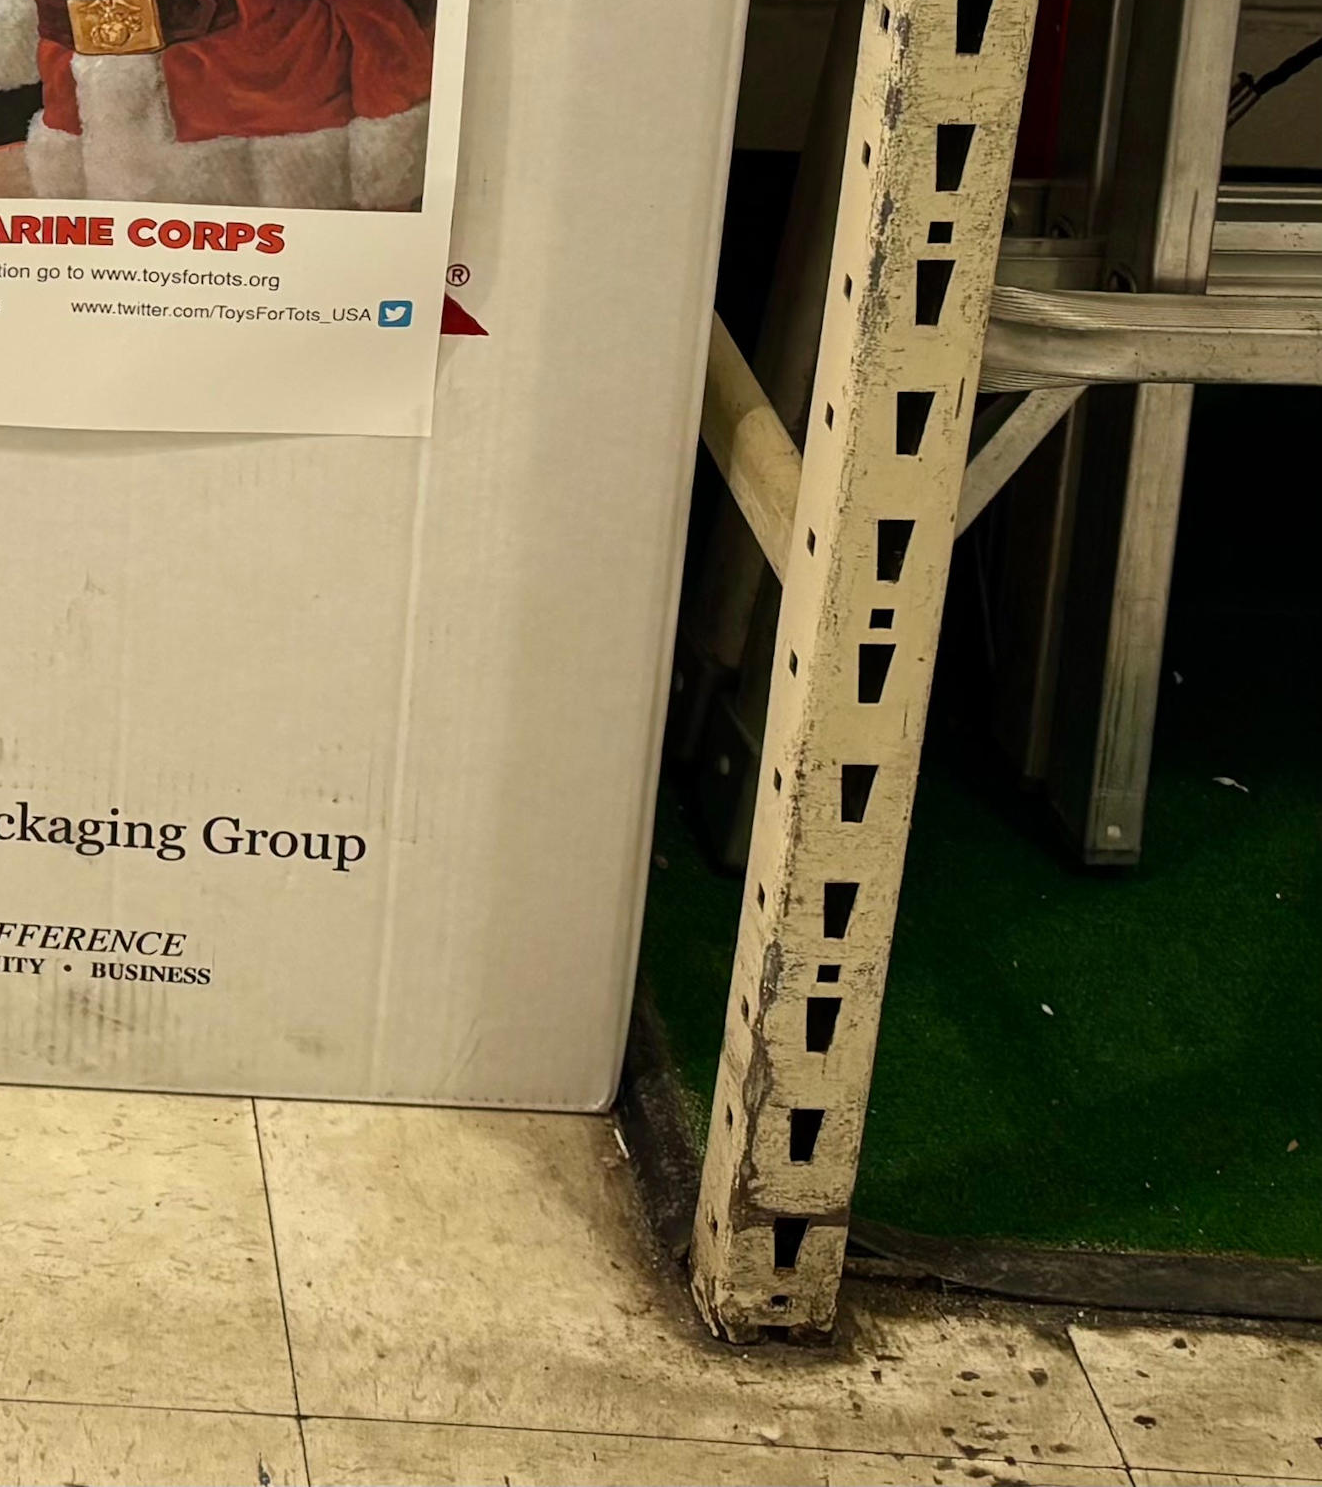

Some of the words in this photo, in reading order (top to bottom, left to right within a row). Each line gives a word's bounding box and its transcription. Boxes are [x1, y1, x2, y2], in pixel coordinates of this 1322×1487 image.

[128, 218, 285, 254] CORPS
[37, 268, 60, 282] go
[68, 265, 84, 279] to
[91, 269, 279, 291] www.toysfortots.org
[71, 303, 371, 324] www.twitter.com/ToysForTots_USA
[203, 817, 365, 872] Group
[91, 962, 210, 984] BUSINESS
